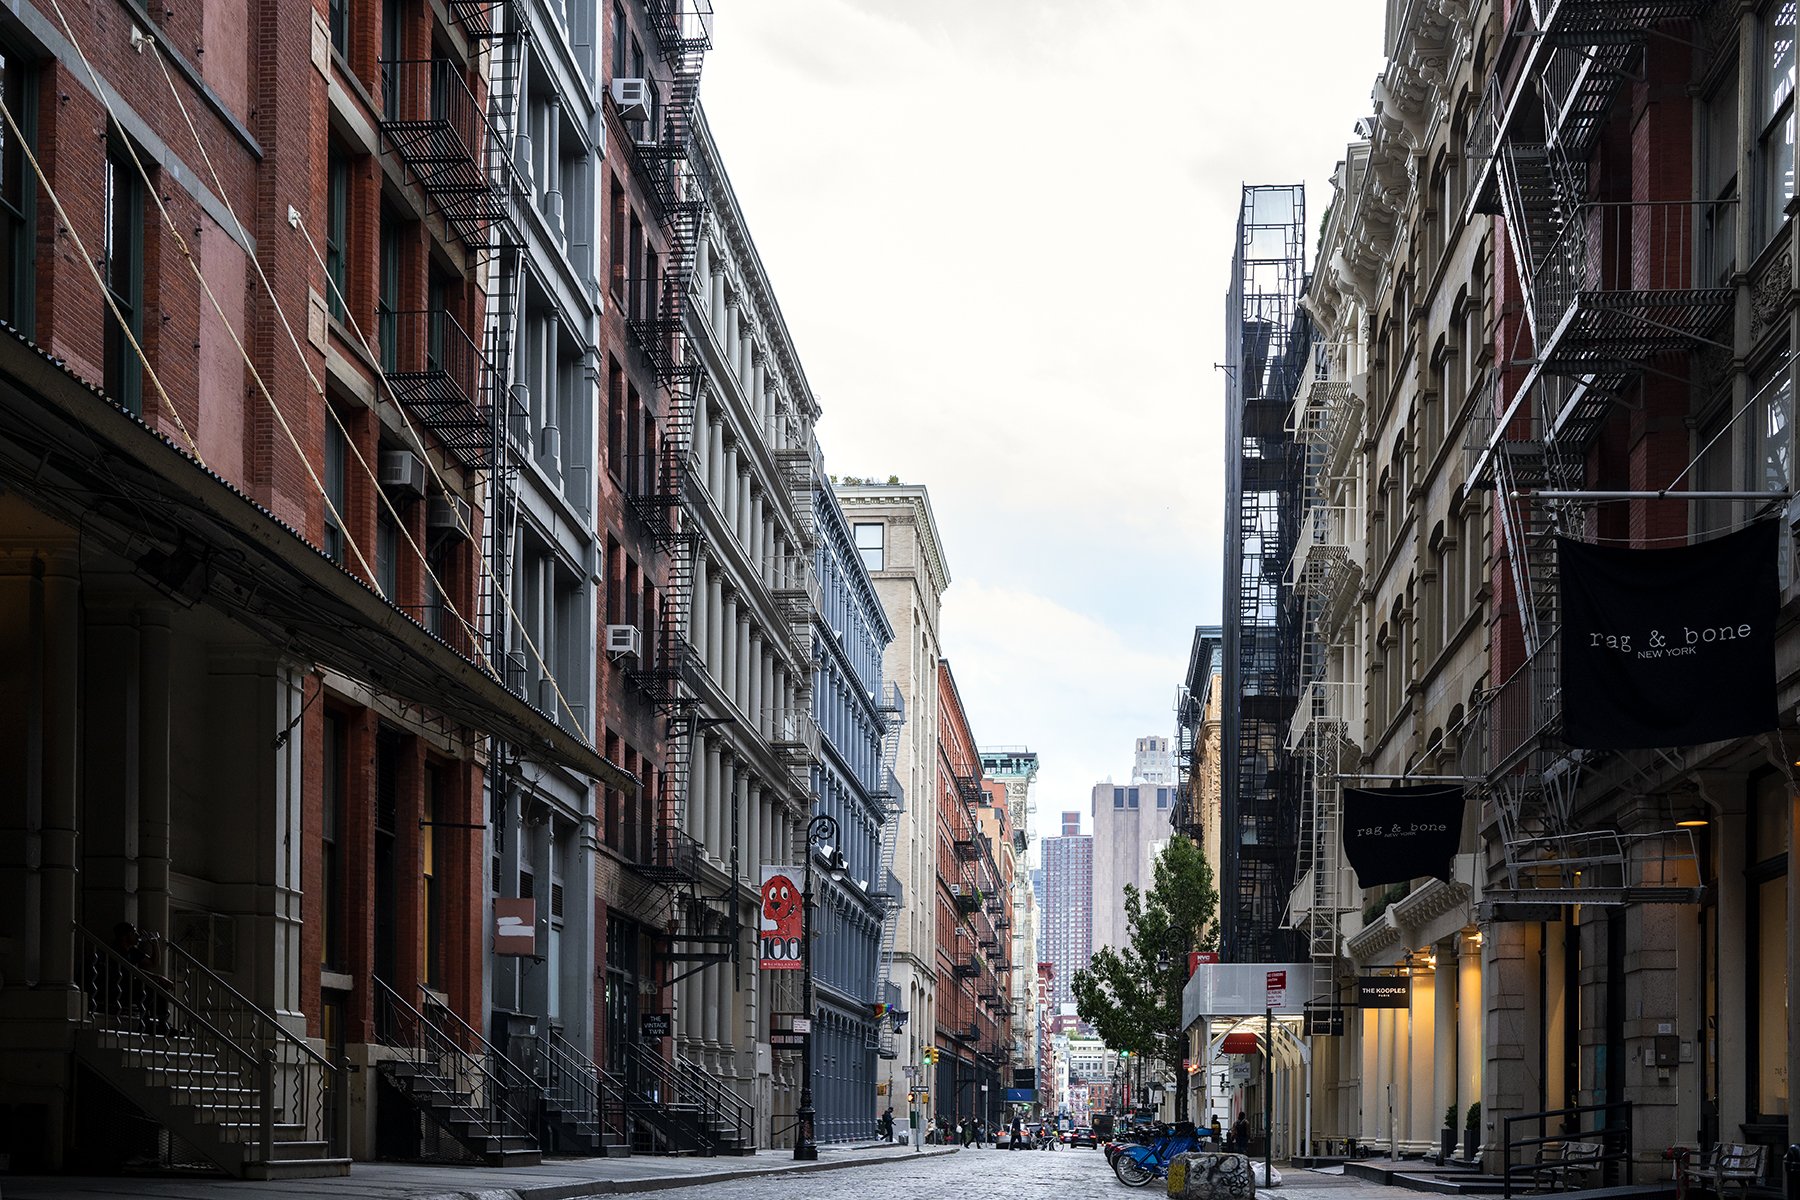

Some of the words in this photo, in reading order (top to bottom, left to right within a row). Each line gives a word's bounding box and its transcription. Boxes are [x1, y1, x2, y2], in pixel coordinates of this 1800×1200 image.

[1590, 632, 1632, 652] rag
[1649, 630, 1666, 648] &
[1684, 624, 1751, 644] bone
[1637, 650, 1663, 659] NEW
[1666, 646, 1696, 656] YORK
[1357, 826, 1382, 837] rag
[1391, 823, 1401, 833] &
[1410, 823, 1447, 832] bone
[760, 936, 801, 960] 100
